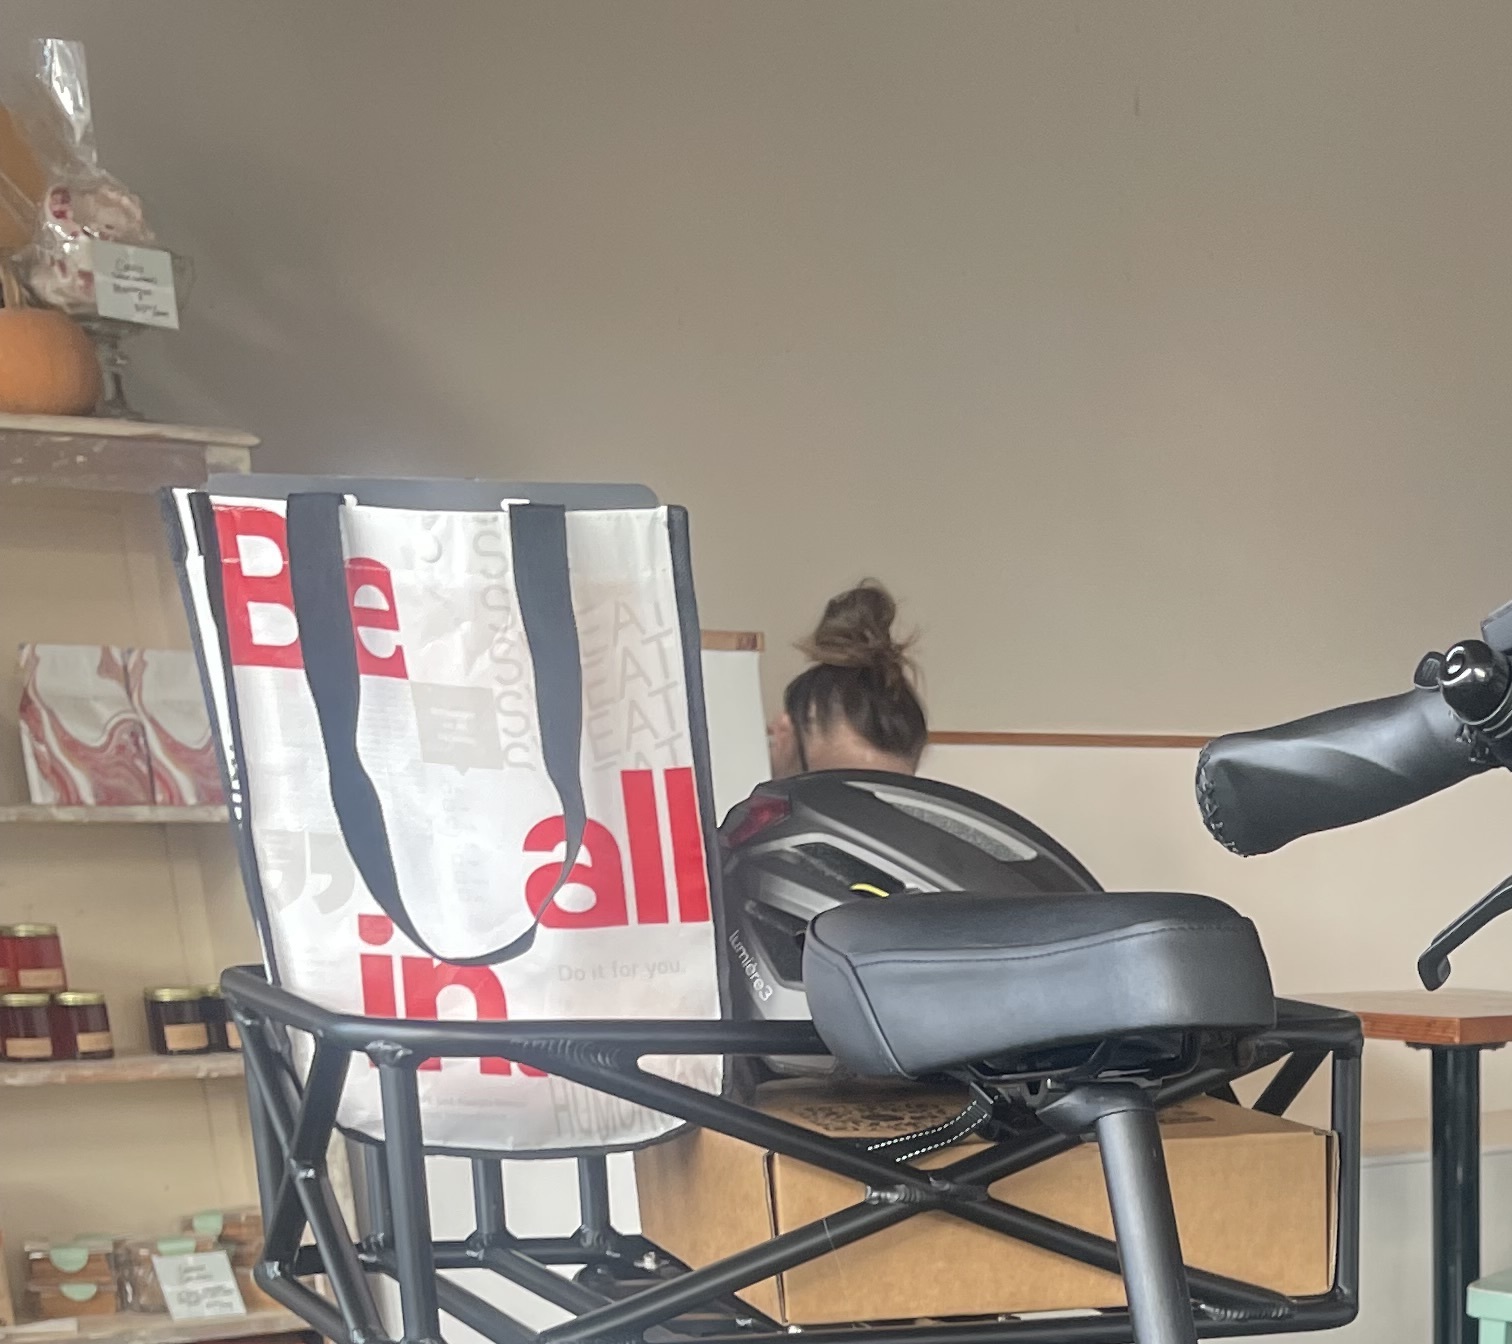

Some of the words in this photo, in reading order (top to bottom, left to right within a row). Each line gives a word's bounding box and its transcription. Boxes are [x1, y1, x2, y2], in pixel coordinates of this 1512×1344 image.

[521, 767, 710, 929] all
[558, 964, 586, 982] Do
[592, 963, 605, 980] it
[612, 960, 638, 978] for
